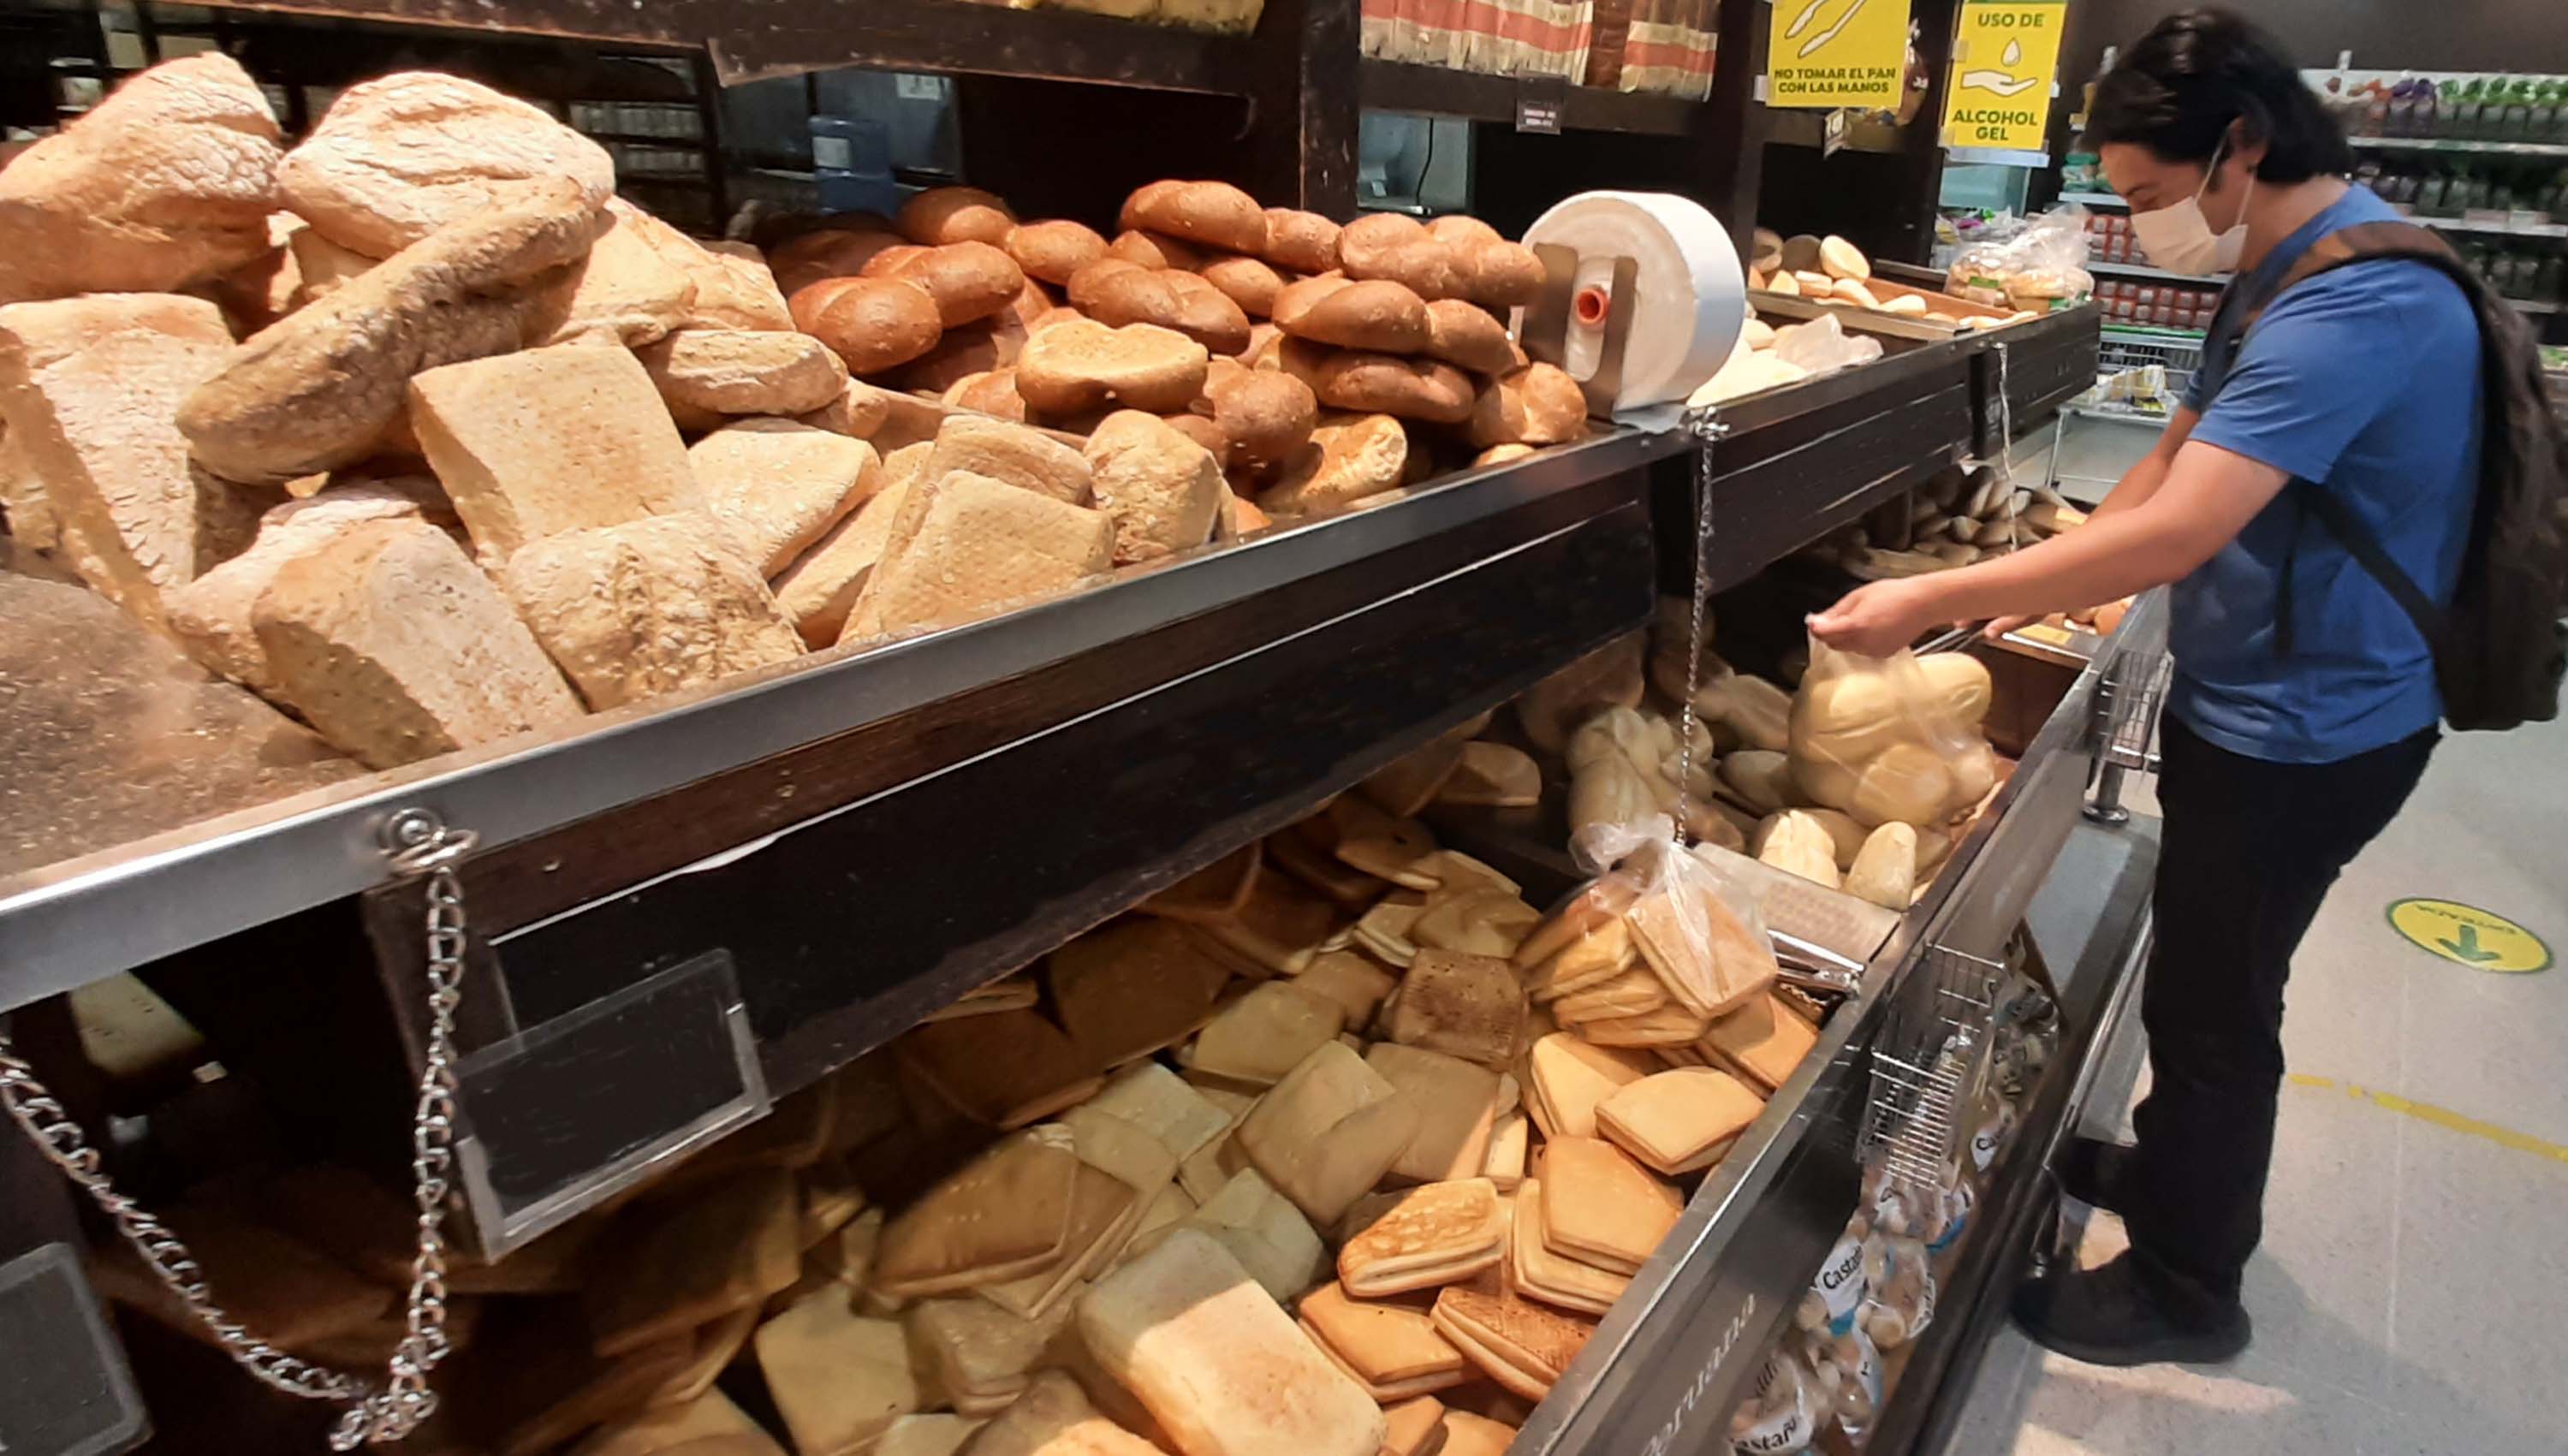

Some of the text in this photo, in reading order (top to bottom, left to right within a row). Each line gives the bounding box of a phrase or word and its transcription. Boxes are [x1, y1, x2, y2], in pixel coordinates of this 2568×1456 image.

[1977, 13, 2045, 27] USO DE
[1774, 68, 1896, 79] NO TOMAR EL PAN
[1778, 82, 1889, 92] CON LAS MANOS
[1952, 109, 2038, 126] ALCOHOL
[1976, 127, 2009, 141] GEL
